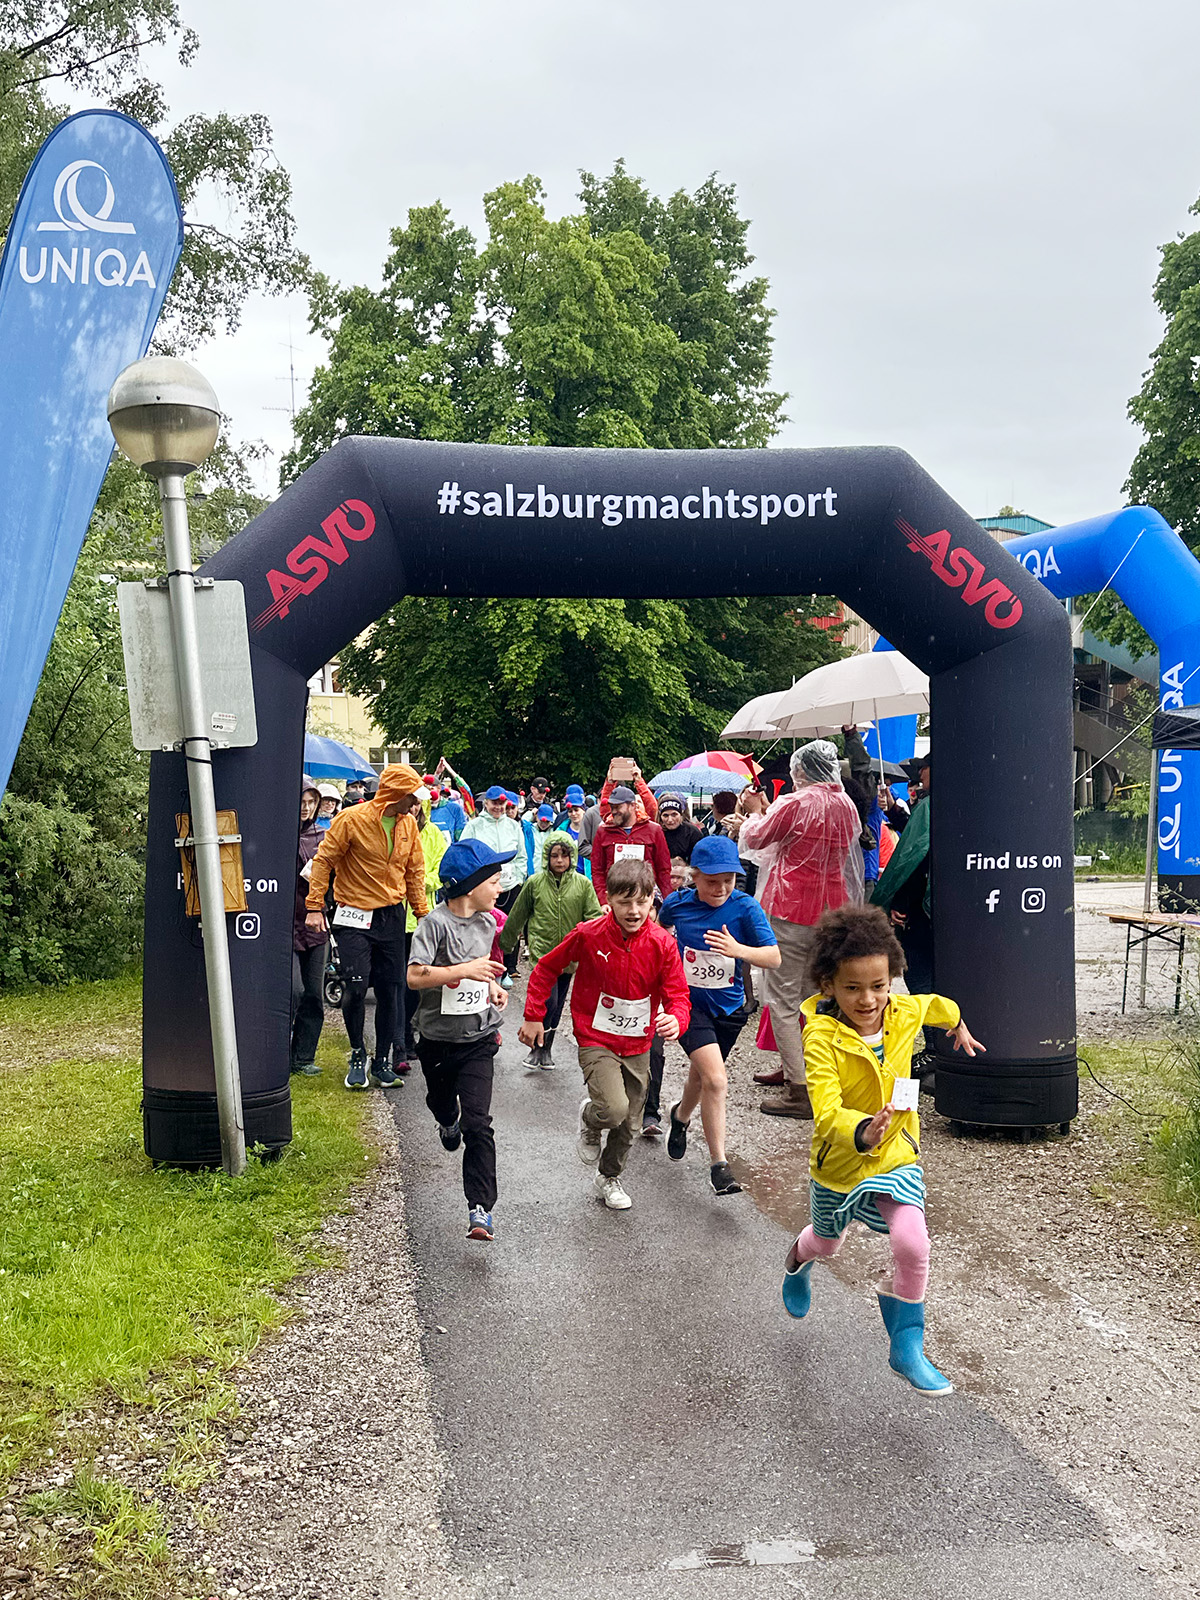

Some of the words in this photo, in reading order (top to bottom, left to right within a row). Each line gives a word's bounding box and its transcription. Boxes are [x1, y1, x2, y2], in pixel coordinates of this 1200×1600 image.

[19, 246, 157, 289] UNIQA
[436, 481, 839, 526] #salzburgmachtsport
[966, 851, 1010, 870] Find
[1015, 855, 1038, 869] us
[1042, 855, 1062, 869] on
[256, 878, 278, 893] on
[340, 909, 365, 923] 2264
[691, 964, 725, 981] 2389
[607, 1012, 639, 1029] 2373
